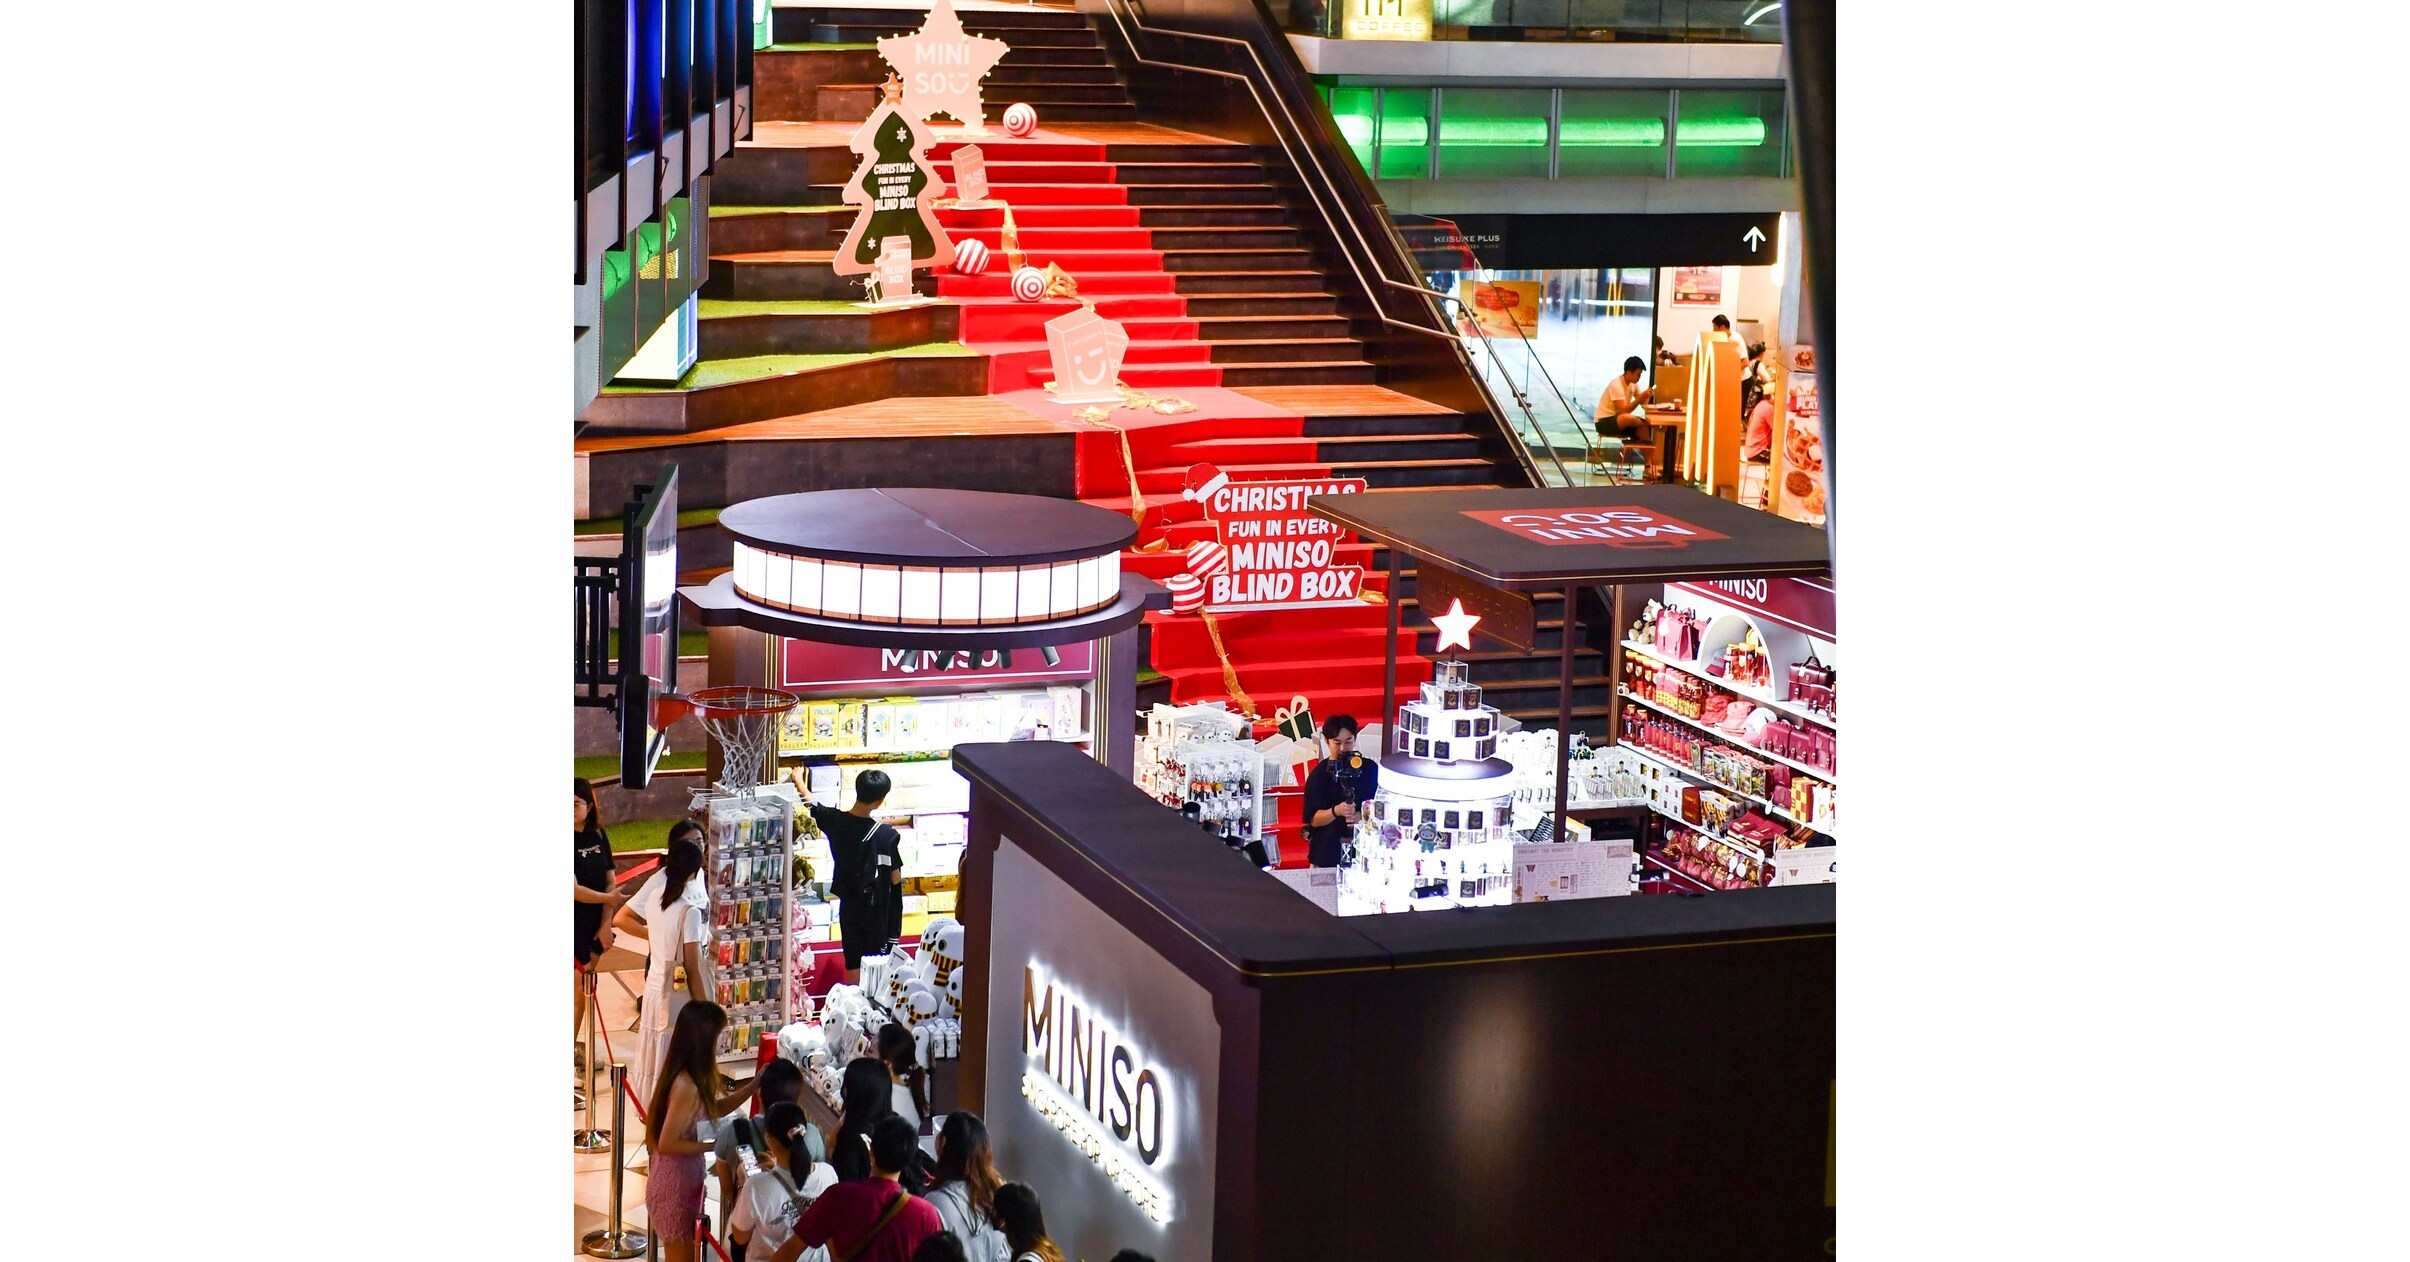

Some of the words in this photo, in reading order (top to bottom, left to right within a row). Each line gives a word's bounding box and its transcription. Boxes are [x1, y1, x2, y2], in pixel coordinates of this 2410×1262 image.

[1357, 21, 1423, 32] COFFEE
[915, 42, 970, 65] MINI
[873, 162, 916, 175] CHRISTMAS
[878, 177, 889, 185] FUN
[889, 176, 895, 184] IN
[895, 175, 912, 184] EVERY
[879, 184, 909, 199] MINISO
[874, 198, 899, 212] BLIND
[899, 196, 917, 210] BOX
[1477, 234, 1501, 242] PLUS
[1228, 520, 1261, 538] FUN
[1265, 519, 1282, 537] IN
[1286, 517, 1339, 536] EVERY
[1528, 524, 1697, 540] MINI
[1232, 539, 1331, 572] MINISO
[1212, 572, 1295, 604] BLIND
[1300, 569, 1356, 600] BOX
[1022, 964, 1164, 1166] MINISO
[1021, 1073, 1080, 1147] SINGAPORE
[1121, 1168, 1161, 1222] STORE
